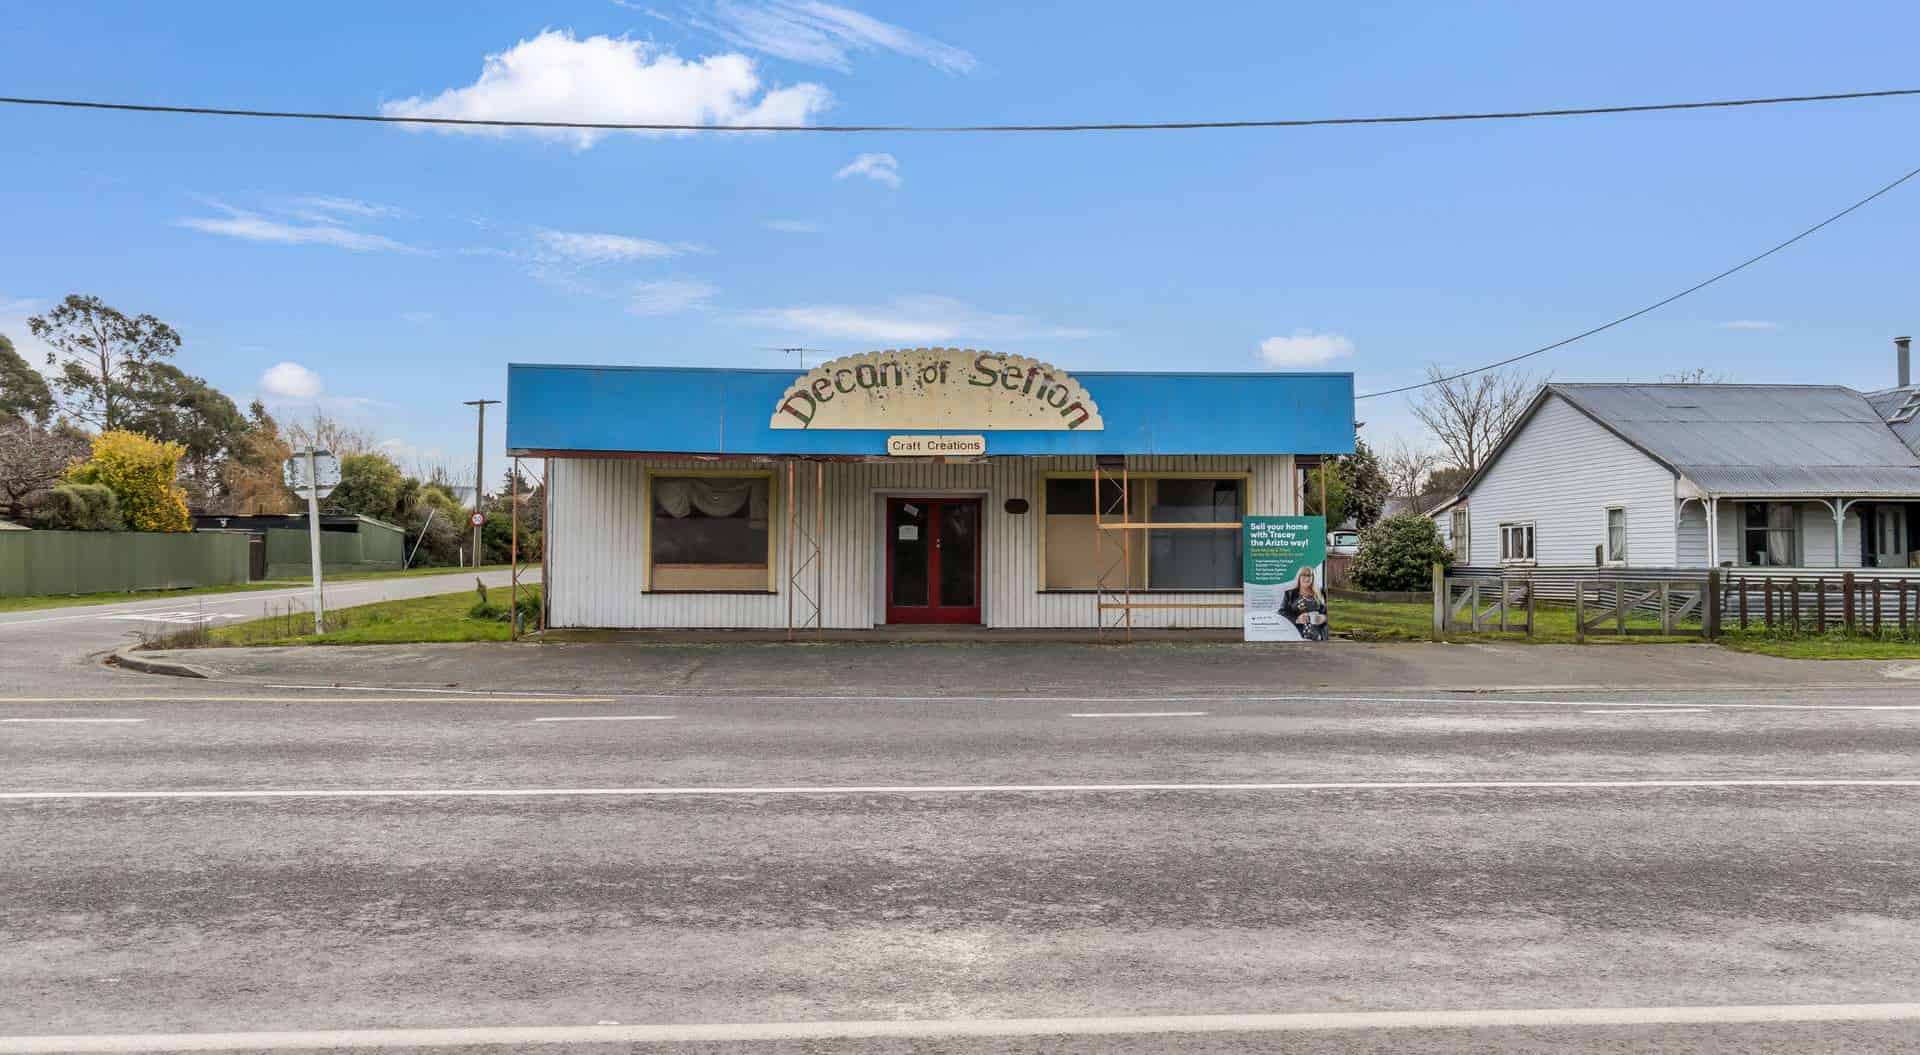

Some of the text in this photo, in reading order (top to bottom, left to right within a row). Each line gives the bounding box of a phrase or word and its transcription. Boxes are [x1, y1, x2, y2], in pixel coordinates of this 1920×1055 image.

[923, 360, 951, 384] of
[893, 440, 981, 451] Craft Creations
[1250, 522, 1309, 533] Sell your home
[1270, 531, 1296, 539] Tracey
[1290, 538, 1309, 548] way!
